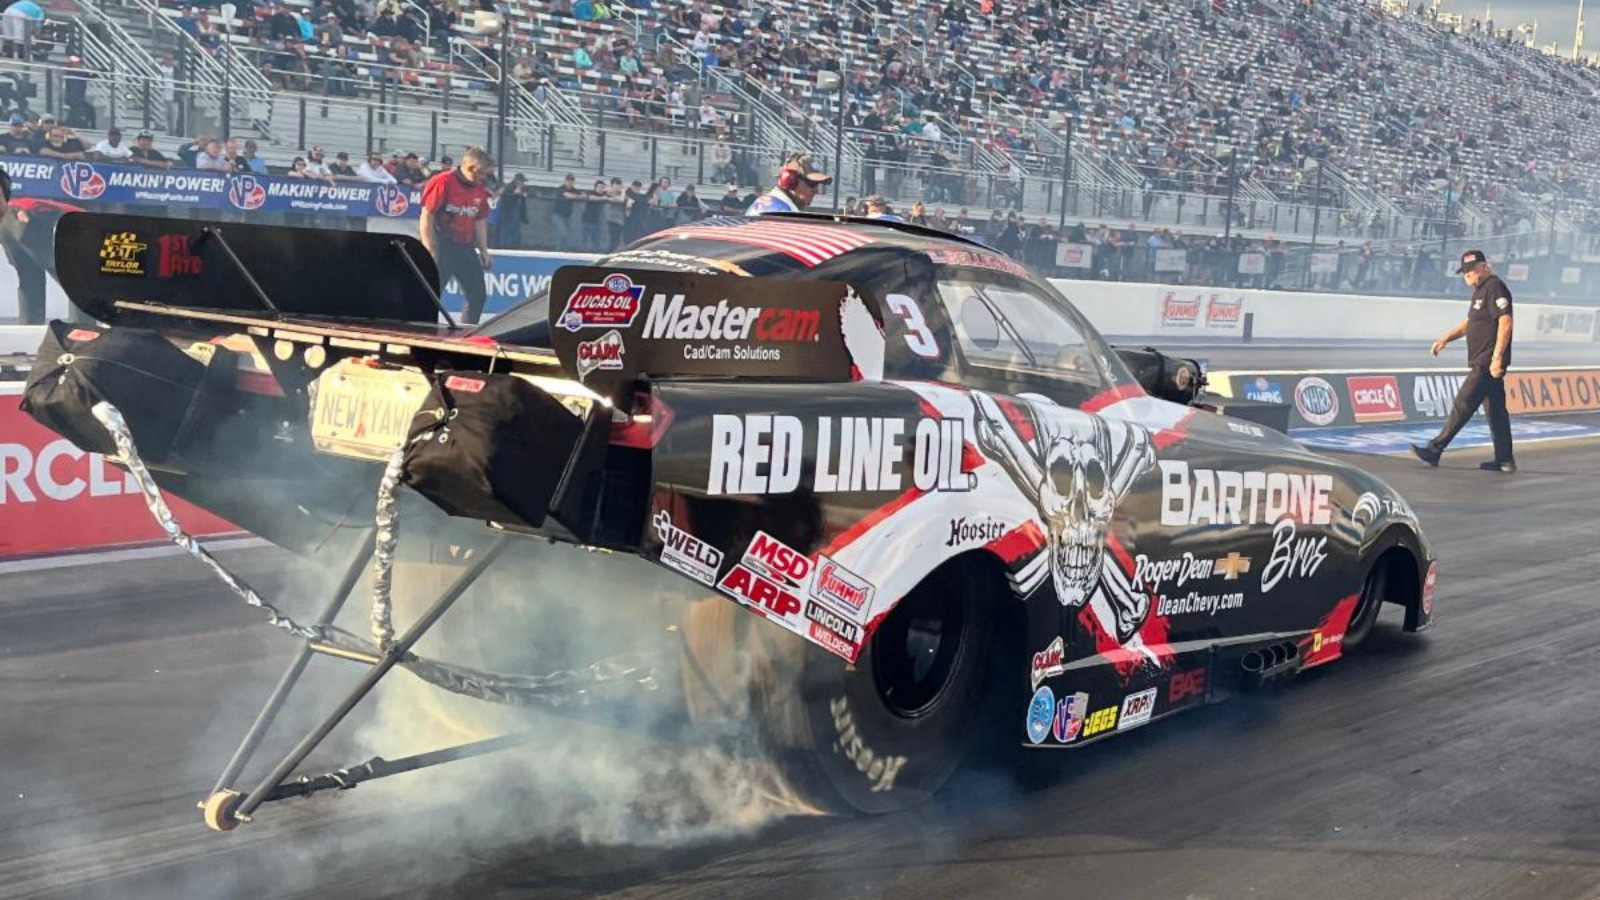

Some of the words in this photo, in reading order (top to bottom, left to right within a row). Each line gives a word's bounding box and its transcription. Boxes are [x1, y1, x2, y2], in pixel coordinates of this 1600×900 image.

[109, 171, 163, 189] MAKIN'
[164, 174, 225, 193] POWER!
[268, 182, 318, 198] MAKIN'
[318, 184, 371, 202] POWER!
[105, 260, 140, 269] TAYLOR
[573, 295, 613, 309] LUCAS
[612, 296, 633, 310] OIL
[886, 292, 941, 358] 3
[579, 343, 620, 360] CLARK
[683, 344, 732, 360] Cad/Cam
[732, 345, 781, 361] Solutions
[1302, 386, 1334, 414] NHRA
[1354, 388, 1385, 405] CIRCLE
[320, 392, 360, 429] NEW
[371, 398, 411, 438] YAW
[706, 413, 804, 495] RED
[813, 416, 905, 493] LINE
[913, 416, 971, 493] OIL
[1158, 459, 1333, 527] BARTONE
[666, 526, 722, 569] WELD
[945, 515, 1006, 548] Hoosier
[749, 533, 809, 581] MSD
[1261, 518, 1329, 593] Bros
[721, 564, 803, 618] ARP
[816, 561, 868, 611] SUMMIT
[1157, 591, 1244, 617] DeanChevy.com
[807, 601, 856, 641] LINCOLN
[813, 626, 855, 659] WELDERS
[1083, 705, 1119, 738] JEGS
[1123, 693, 1150, 719] XRP
